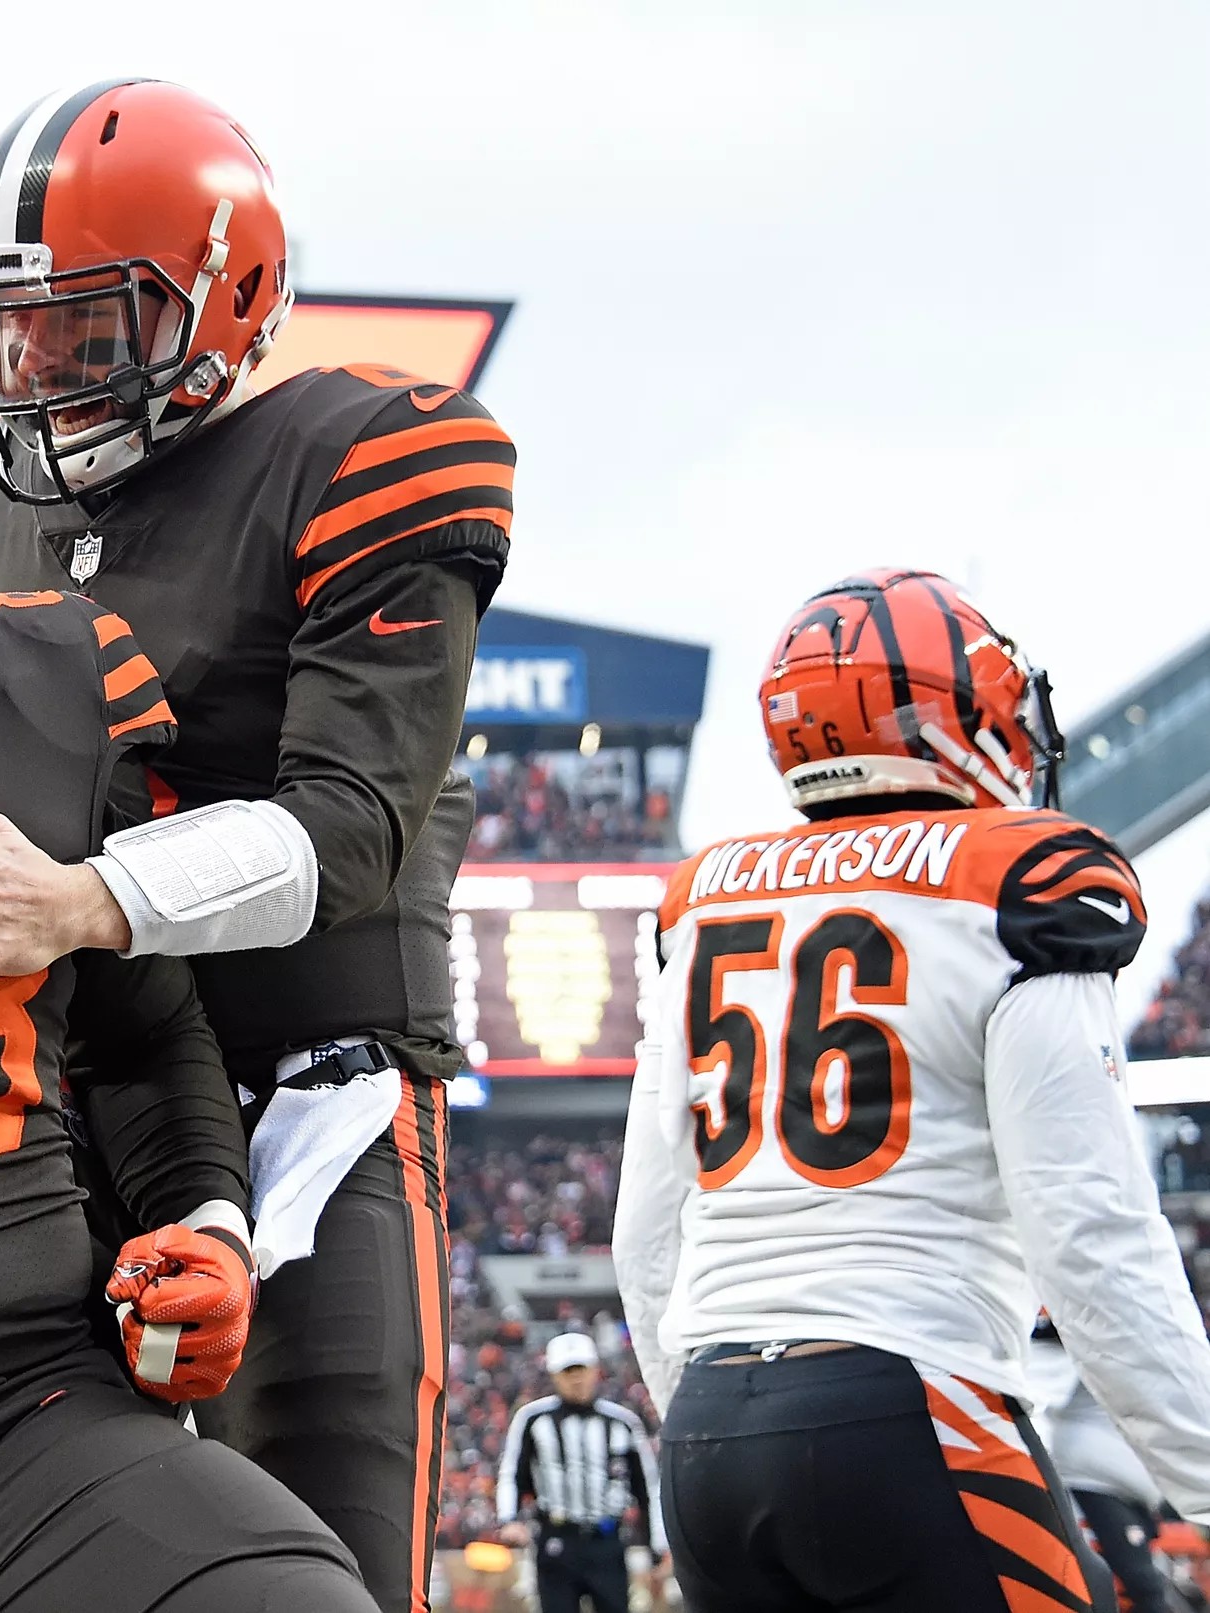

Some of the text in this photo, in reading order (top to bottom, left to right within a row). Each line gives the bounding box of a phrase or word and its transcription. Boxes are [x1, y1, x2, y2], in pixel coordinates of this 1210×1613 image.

[787, 721, 845, 764] 56
[687, 822, 968, 904] NICKERSON
[685, 907, 912, 1189] 56
